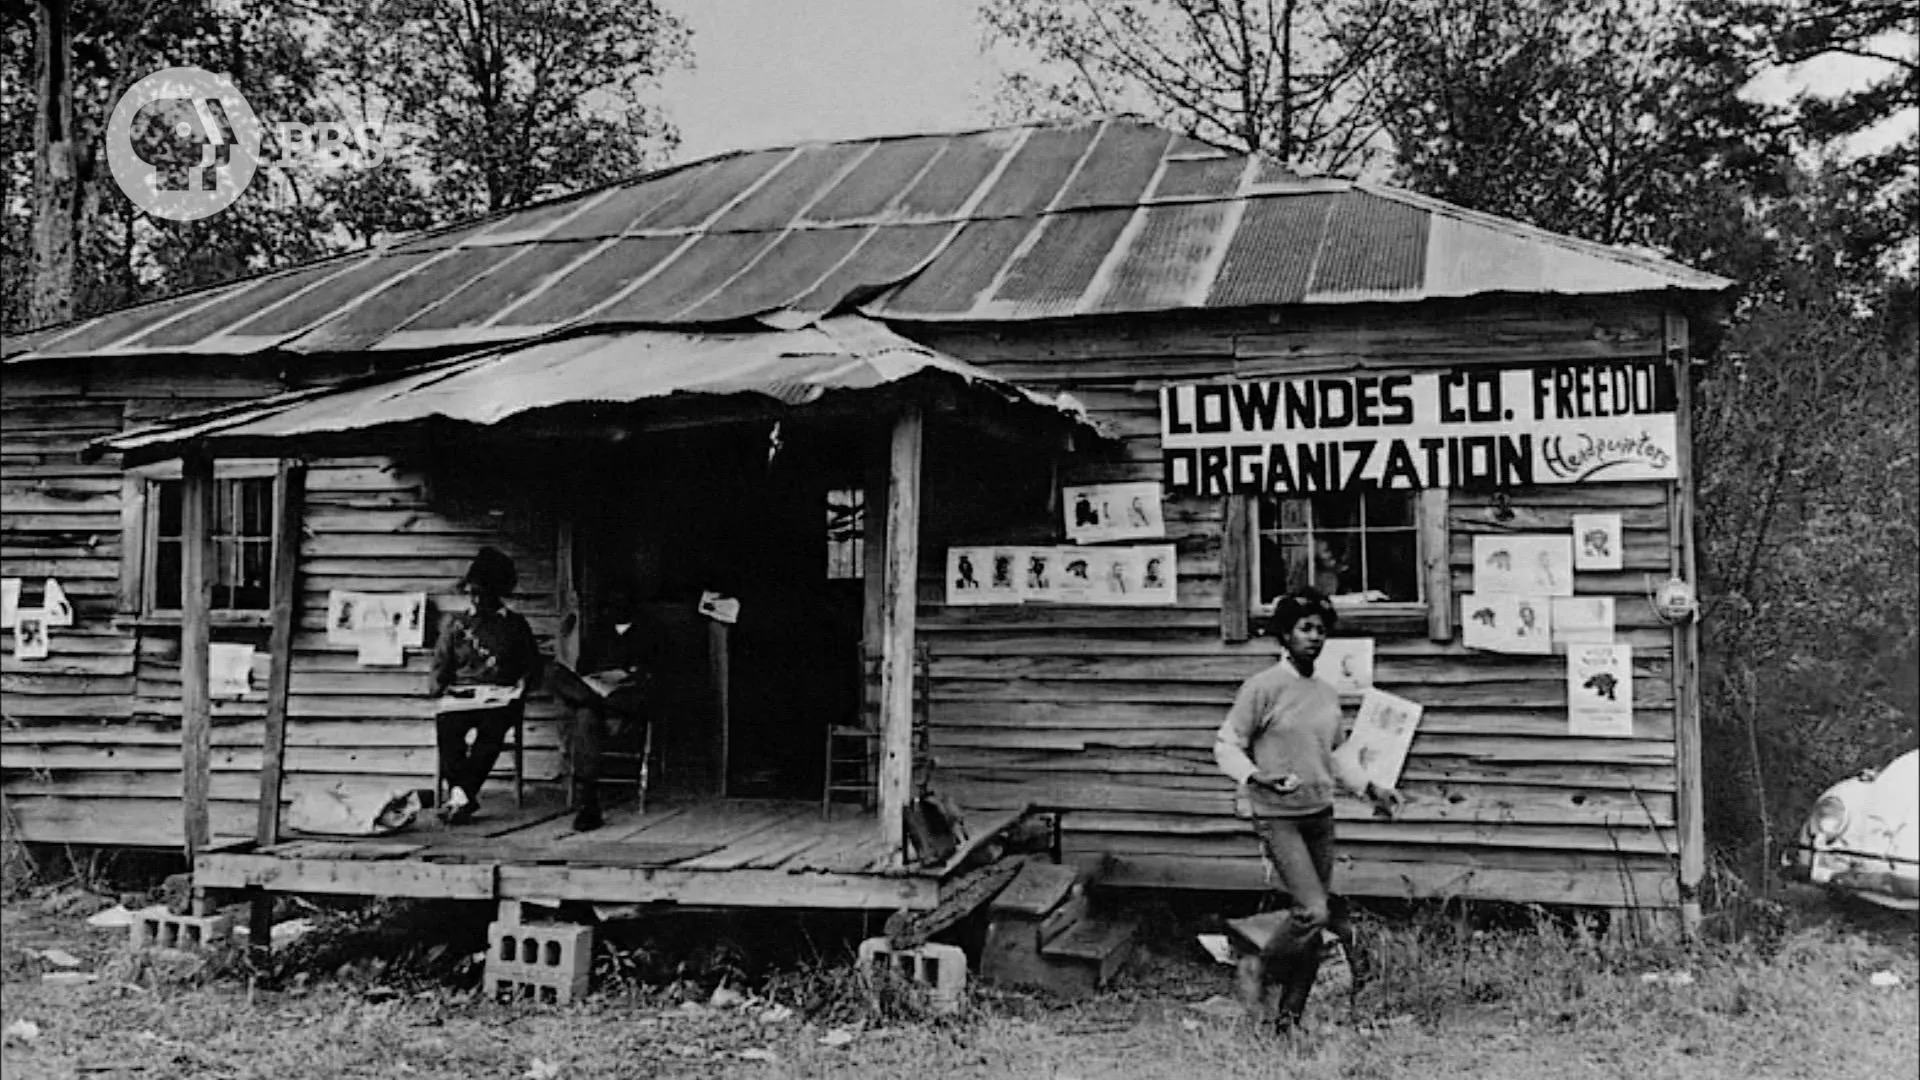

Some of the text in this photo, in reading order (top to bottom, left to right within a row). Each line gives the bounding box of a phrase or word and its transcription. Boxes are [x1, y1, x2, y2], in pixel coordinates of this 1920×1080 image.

[1168, 363, 1678, 434] LOWNDES CO. FREEDO
[1163, 434, 1532, 496] ORGANIZATION
